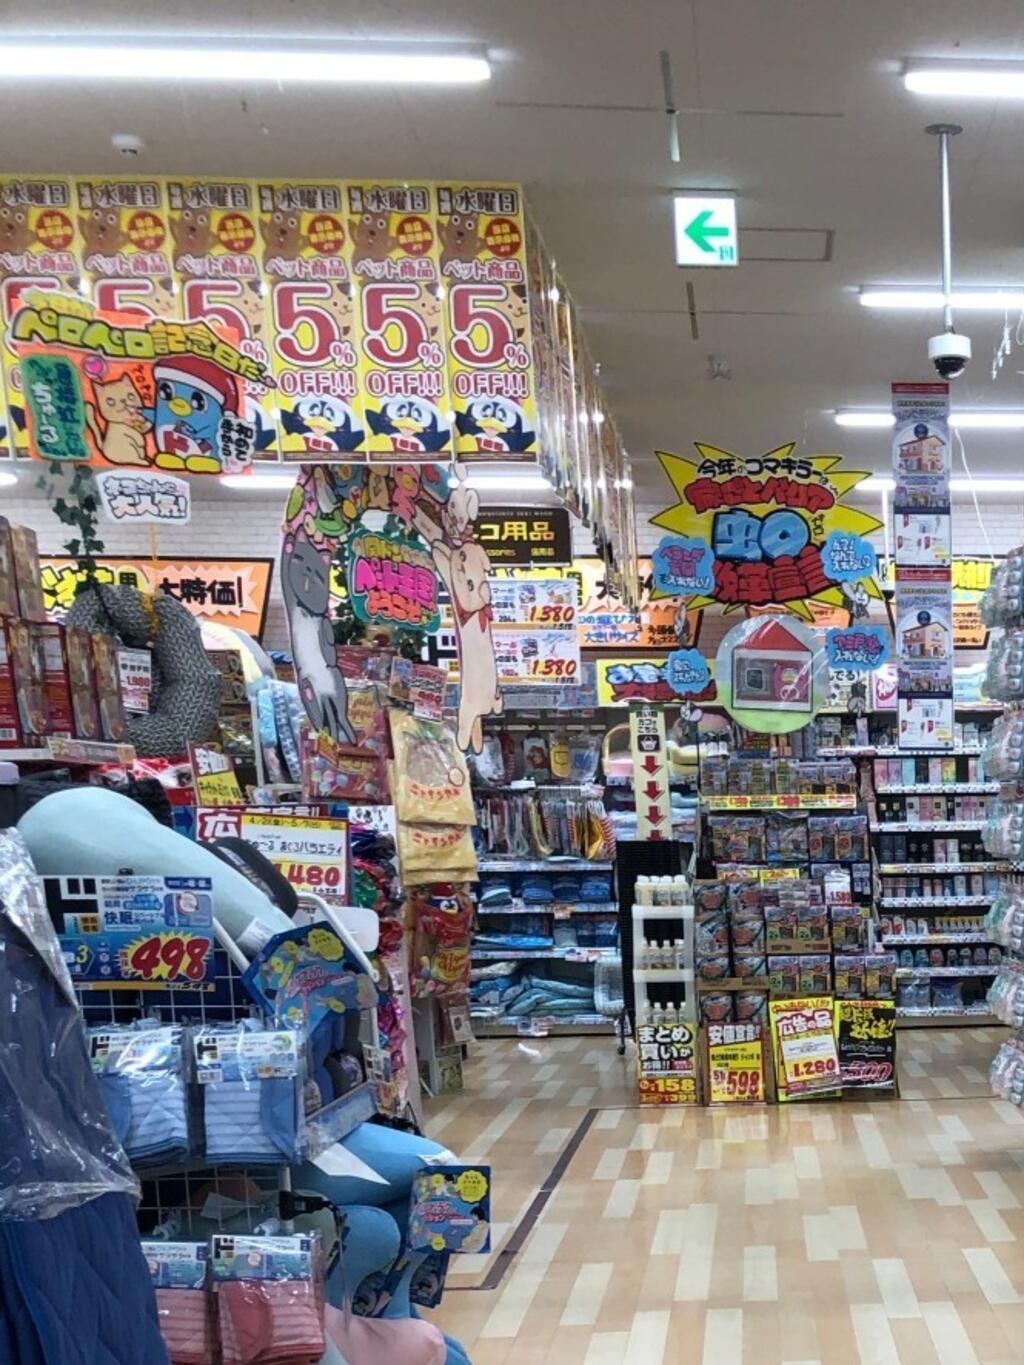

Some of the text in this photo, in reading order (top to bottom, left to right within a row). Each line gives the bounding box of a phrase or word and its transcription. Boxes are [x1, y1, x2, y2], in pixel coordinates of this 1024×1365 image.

[473, 521, 555, 541] コ用品
[131, 936, 212, 981] 498
[639, 1025, 692, 1044] まとめ
[726, 1070, 761, 1096] 598
